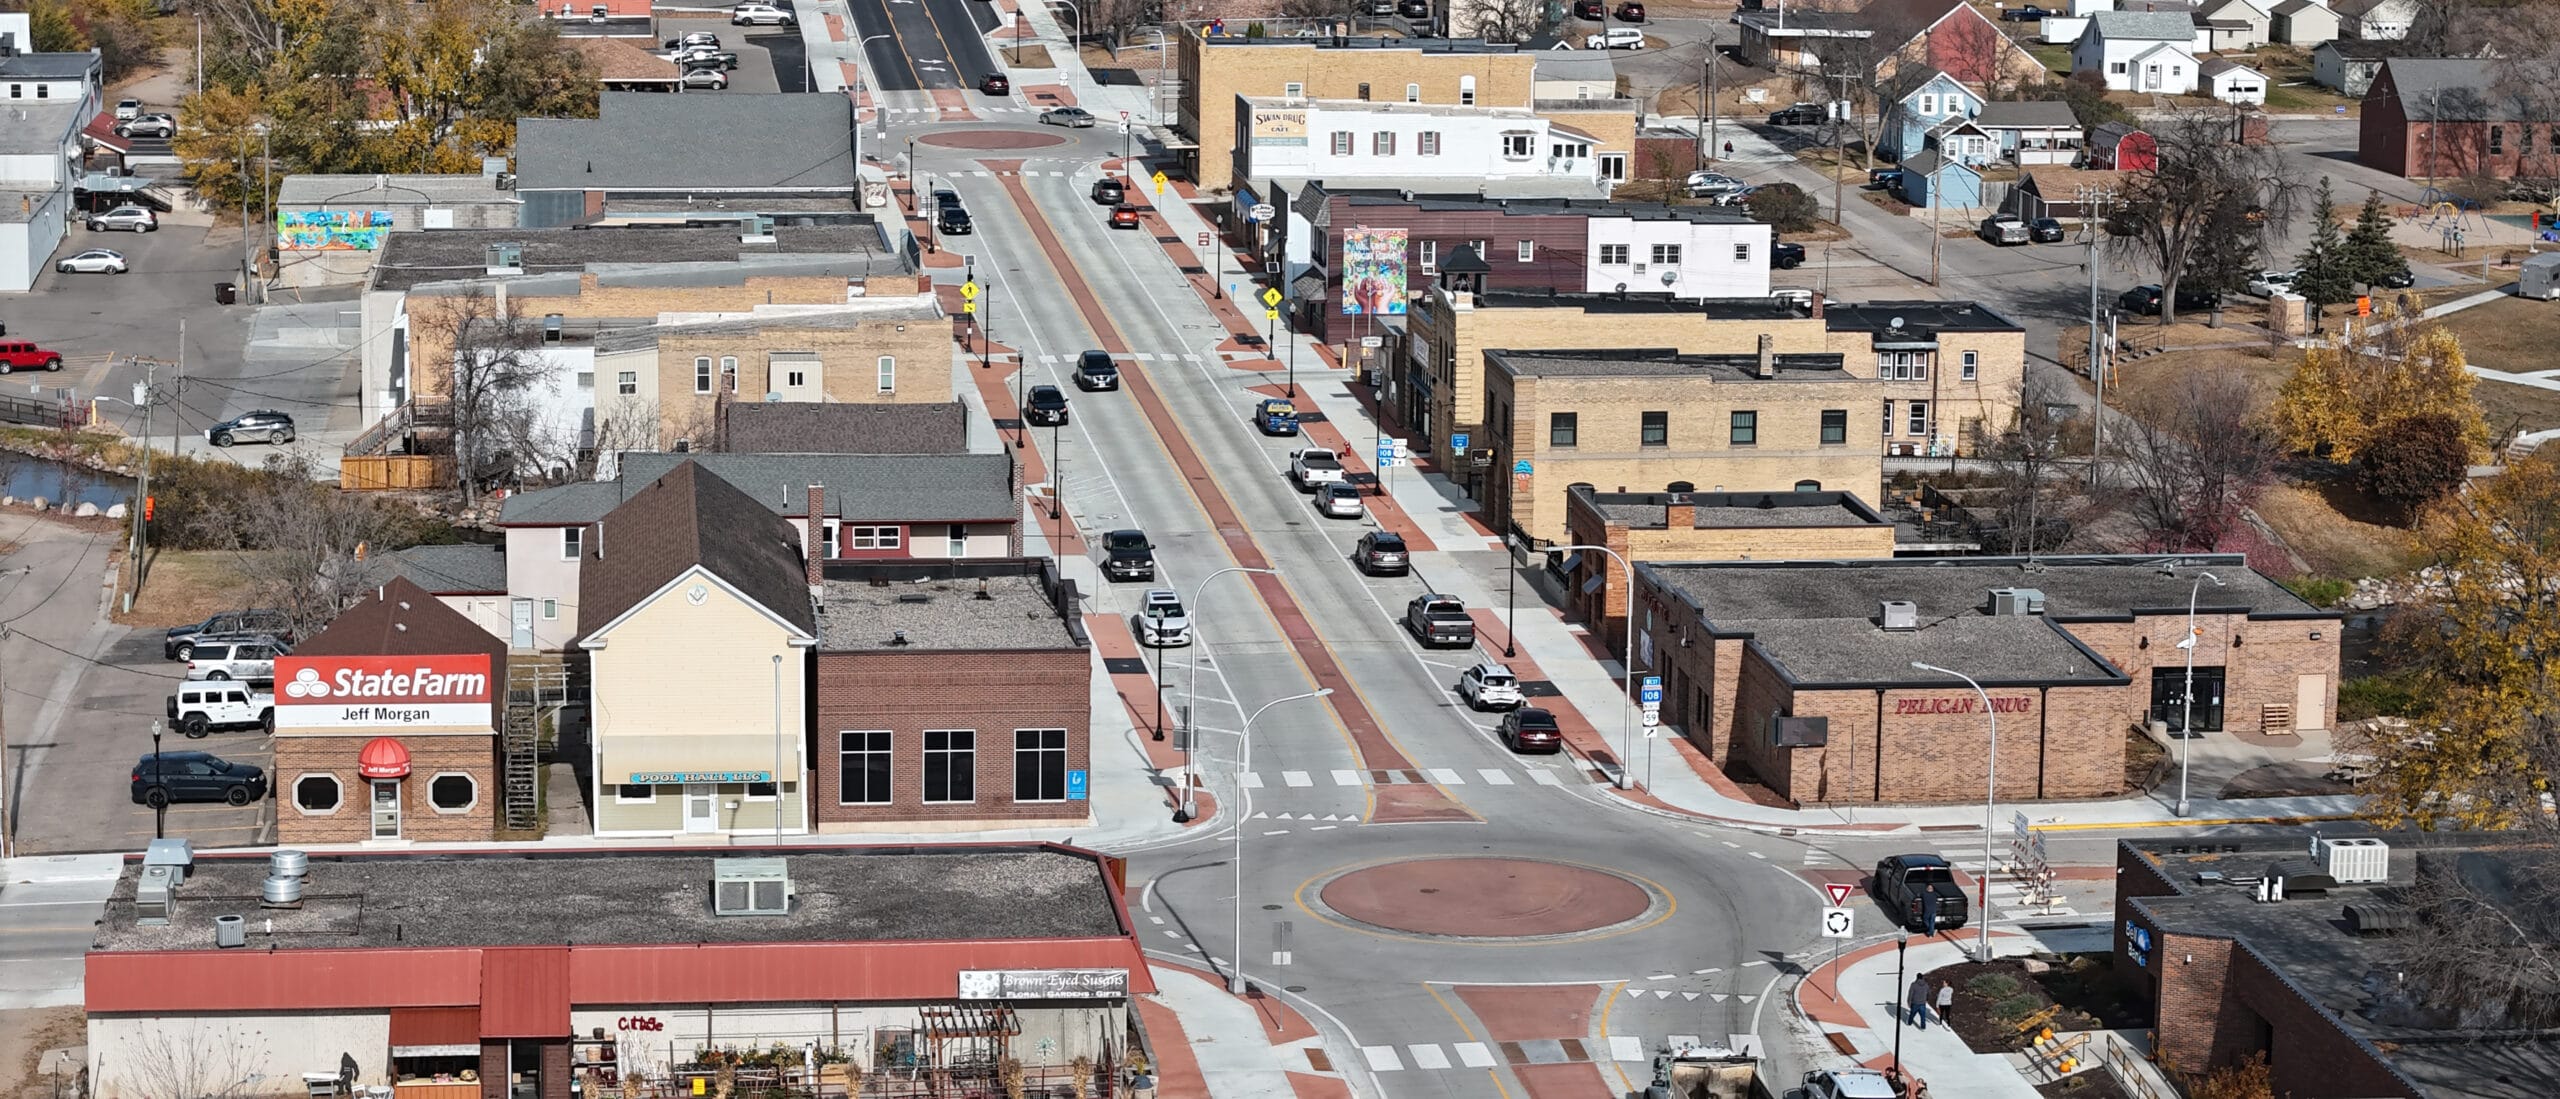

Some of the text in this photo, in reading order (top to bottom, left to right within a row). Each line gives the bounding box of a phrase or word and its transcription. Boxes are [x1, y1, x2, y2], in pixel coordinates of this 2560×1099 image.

[1282, 113, 1306, 126] DRUG
[1644, 690, 1660, 701] 108
[1894, 697, 1975, 715] PELICAN
[341, 707, 430, 723] Jeff Morgan
[1645, 713, 1657, 723] 59
[639, 773, 680, 783] POOL
[685, 773, 728, 783] HALL
[1002, 973, 1125, 990] Brown Eyed Susans
